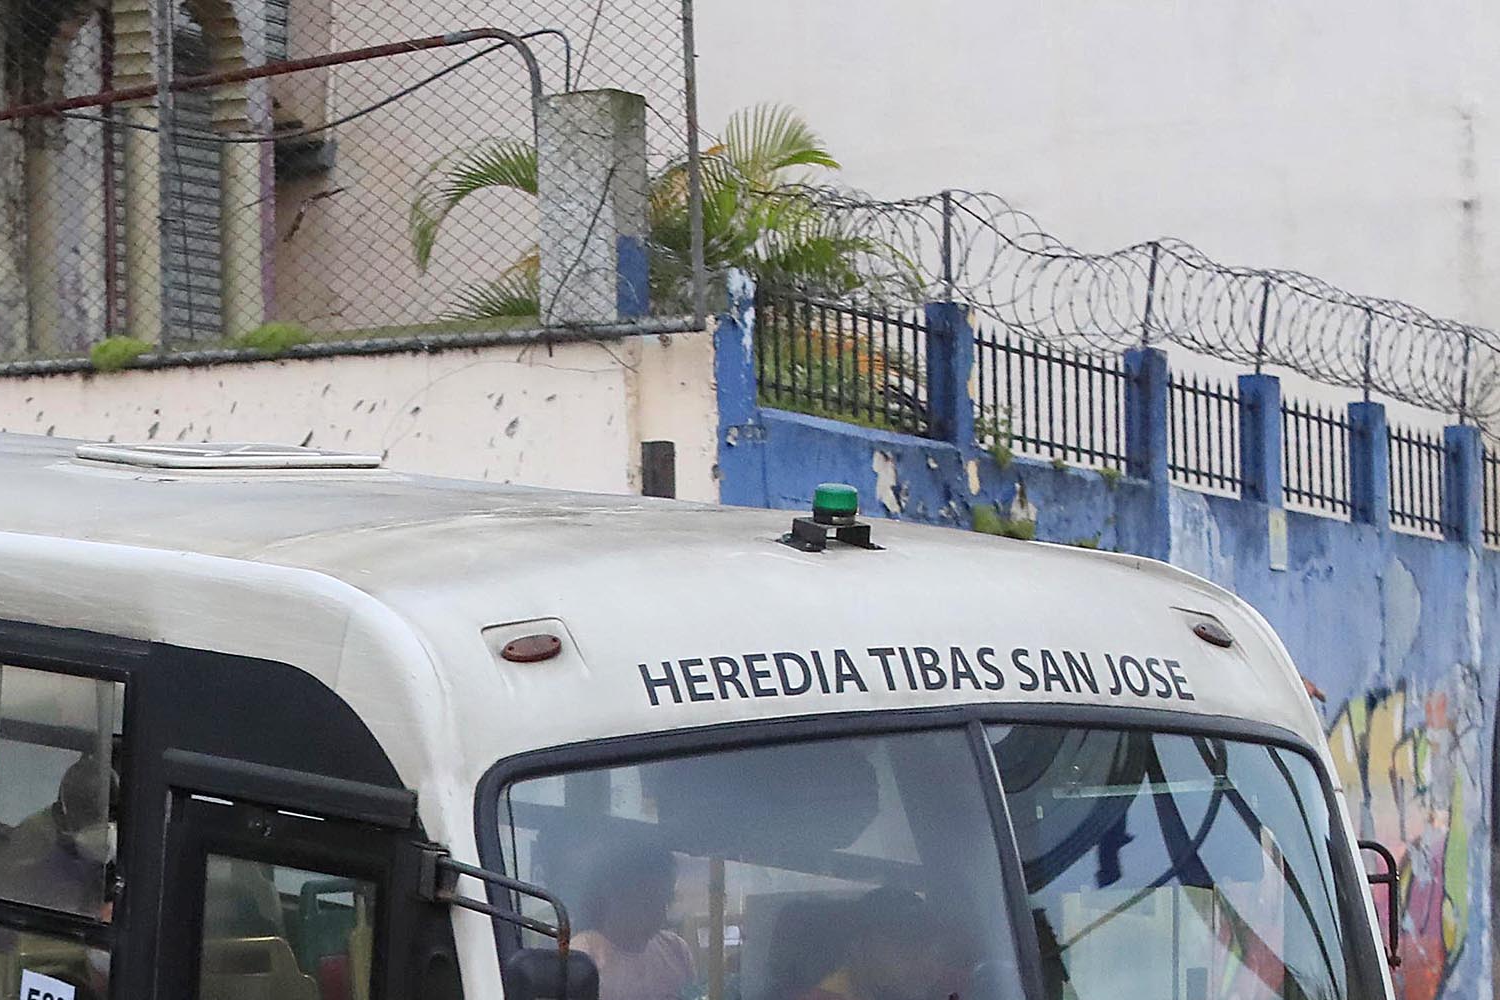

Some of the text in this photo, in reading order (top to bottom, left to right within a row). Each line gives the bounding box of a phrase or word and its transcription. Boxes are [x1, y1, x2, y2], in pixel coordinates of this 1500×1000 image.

[639, 646, 1195, 706] HEREDIA TIBAS SAN JOSE
